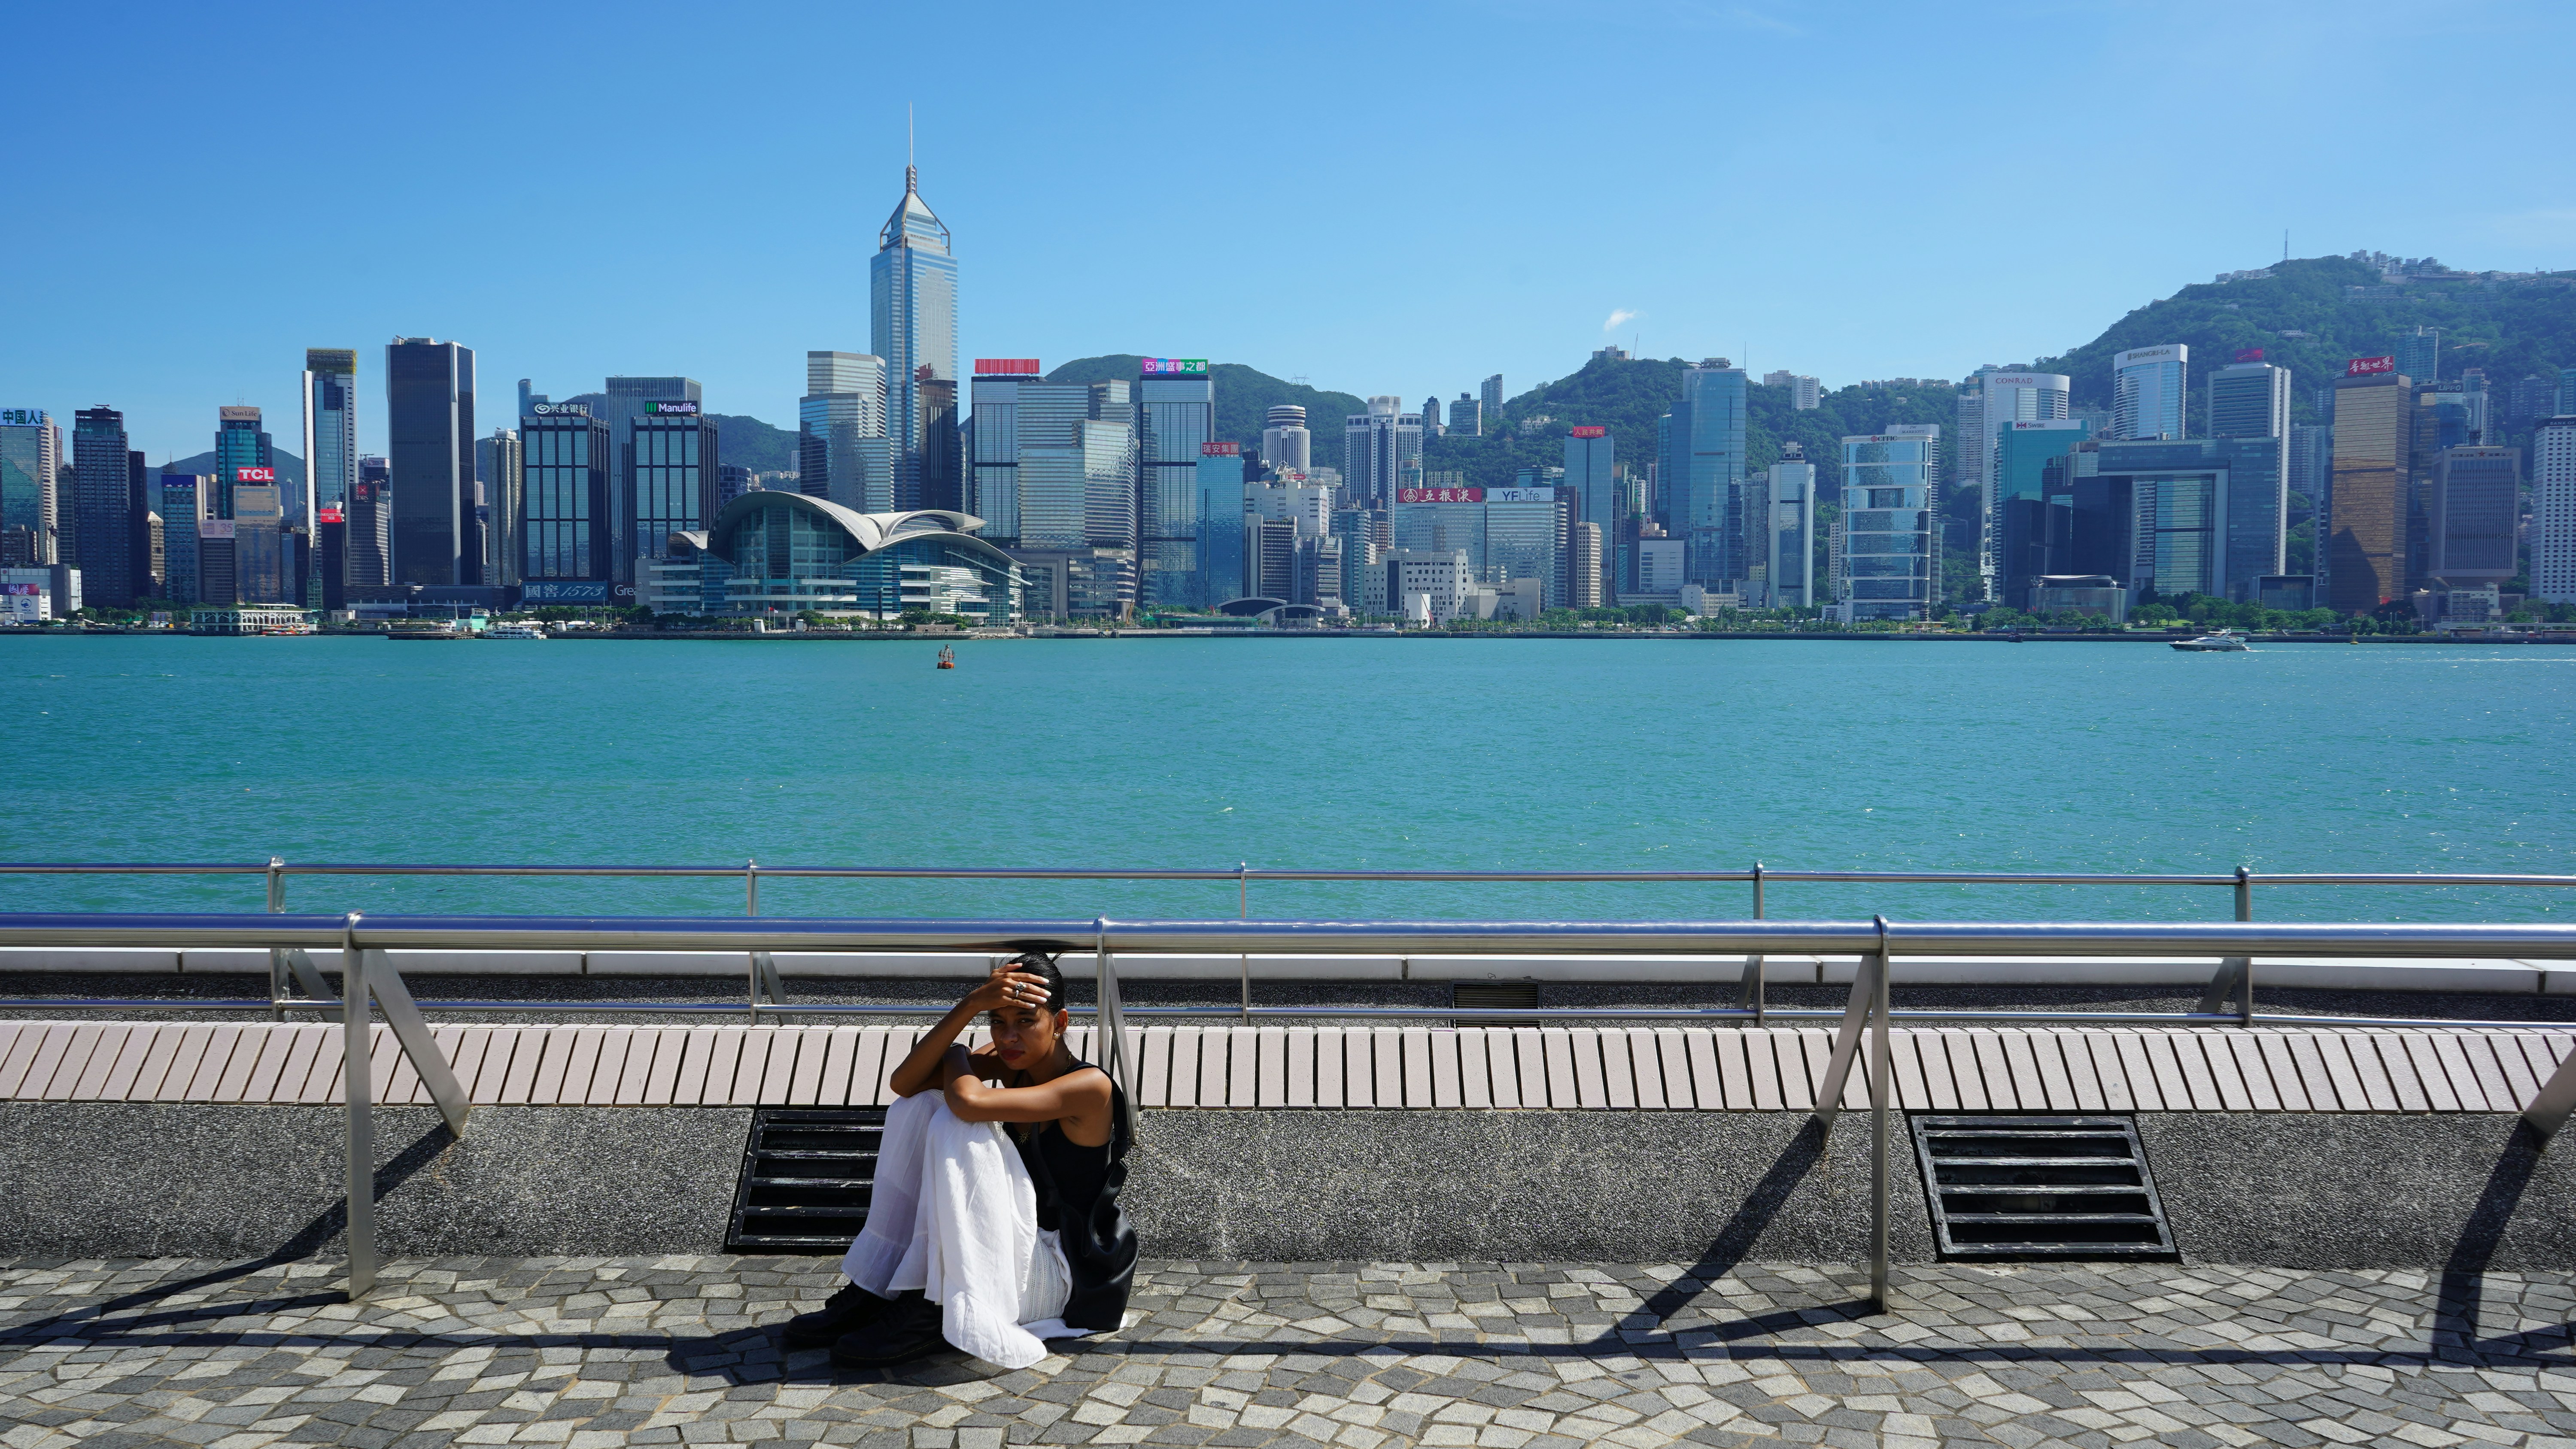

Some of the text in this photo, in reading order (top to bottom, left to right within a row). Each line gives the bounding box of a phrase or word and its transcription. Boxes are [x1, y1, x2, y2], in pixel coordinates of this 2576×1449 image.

[1145, 361, 1205, 371] 亞洲盛事之都
[550, 404, 588, 414] 兴业银行
[659, 403, 696, 412] Manulife
[1203, 444, 1238, 453] 瑞安集團
[239, 469, 274, 480] TCL
